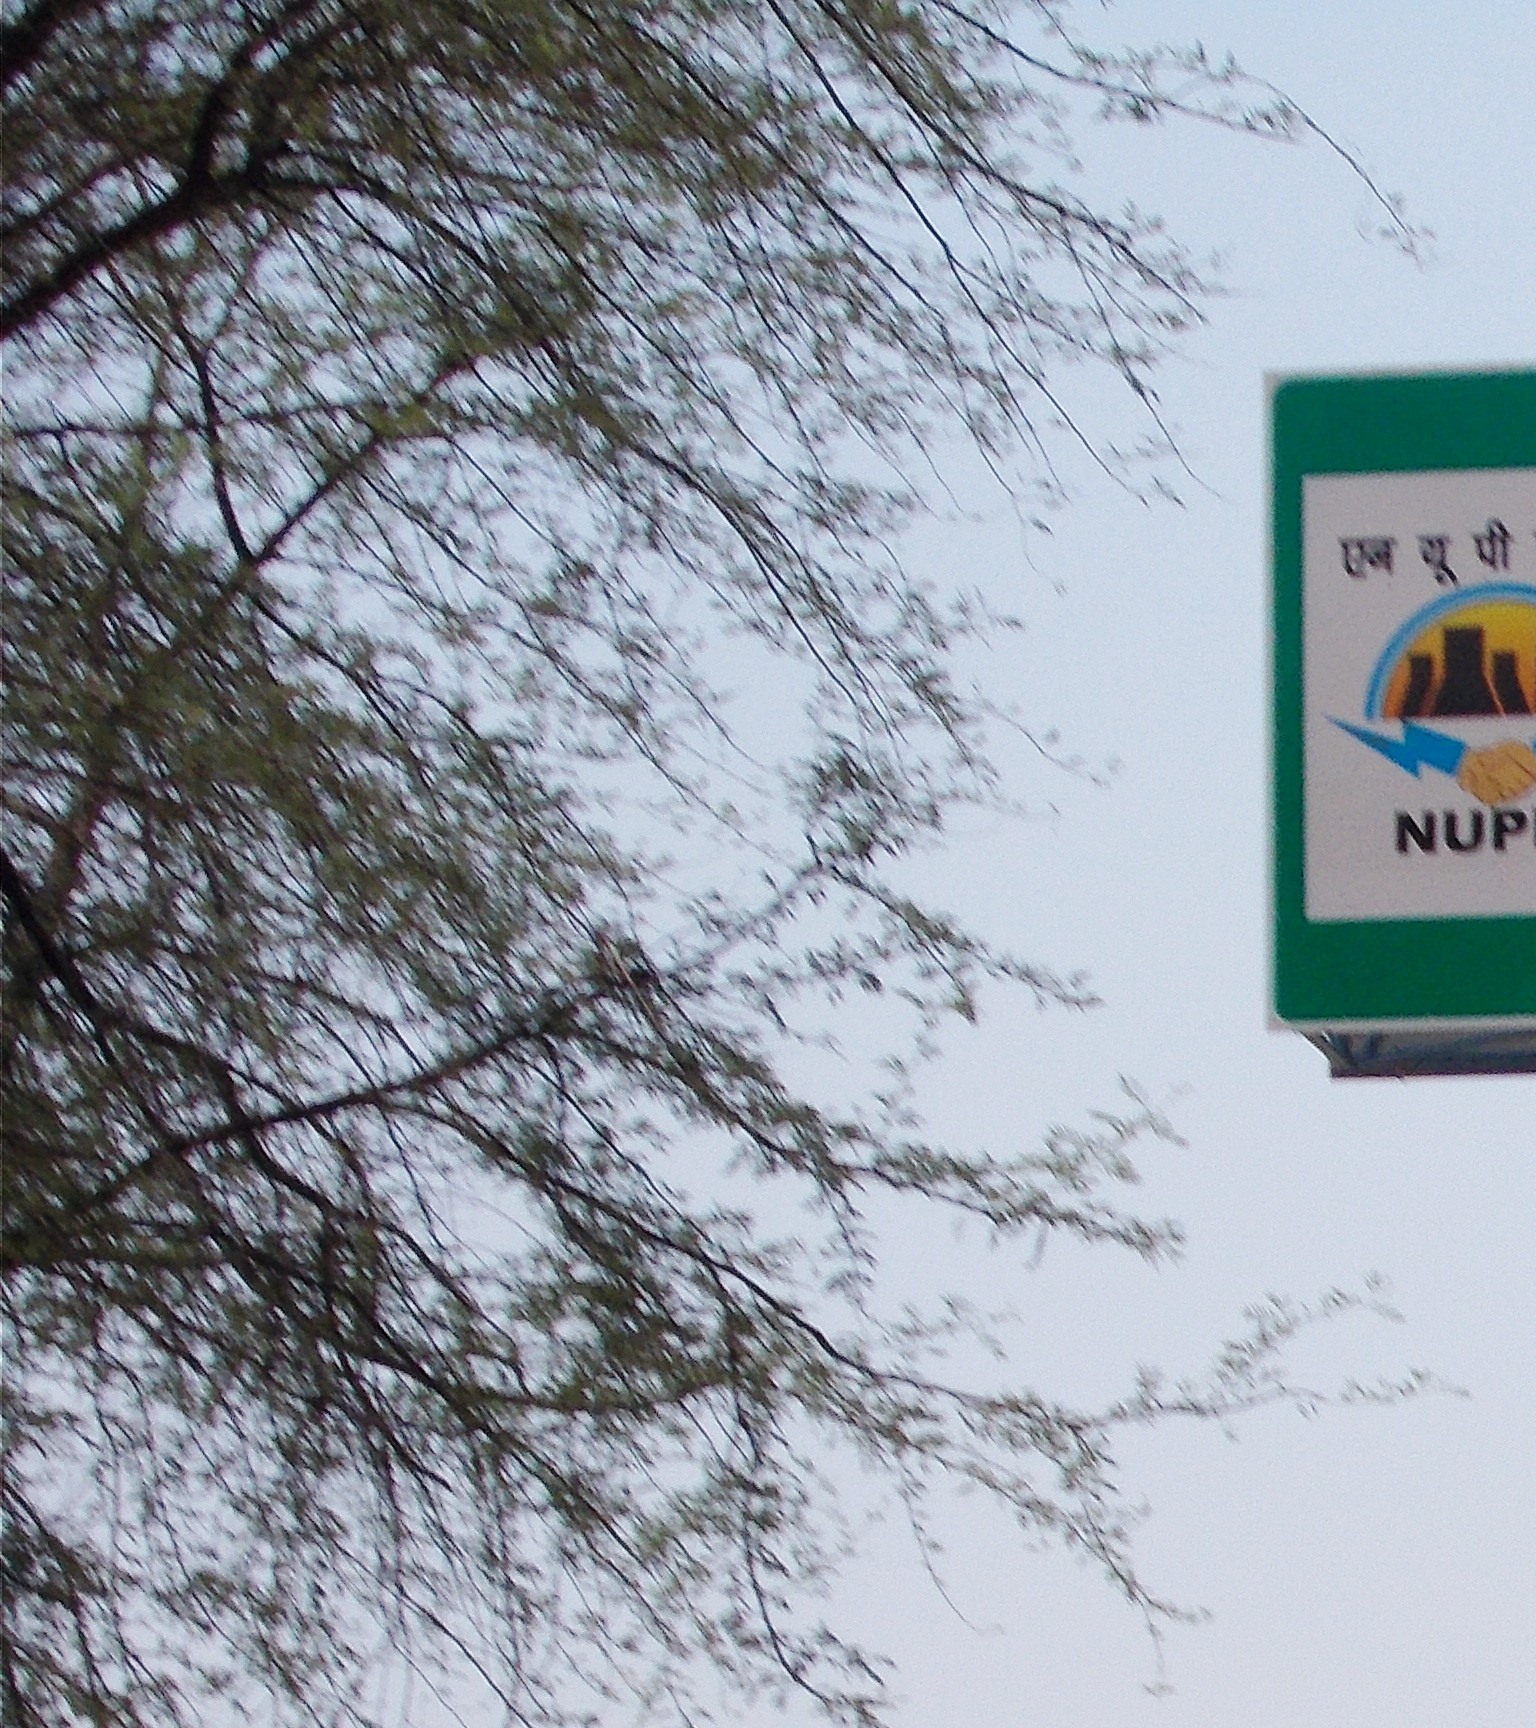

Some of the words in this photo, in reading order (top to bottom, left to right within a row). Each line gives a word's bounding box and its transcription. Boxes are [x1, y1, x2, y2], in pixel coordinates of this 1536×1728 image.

[1337, 534, 1398, 580] एन
[1415, 532, 1460, 587] यू
[1471, 516, 1514, 571] पी
